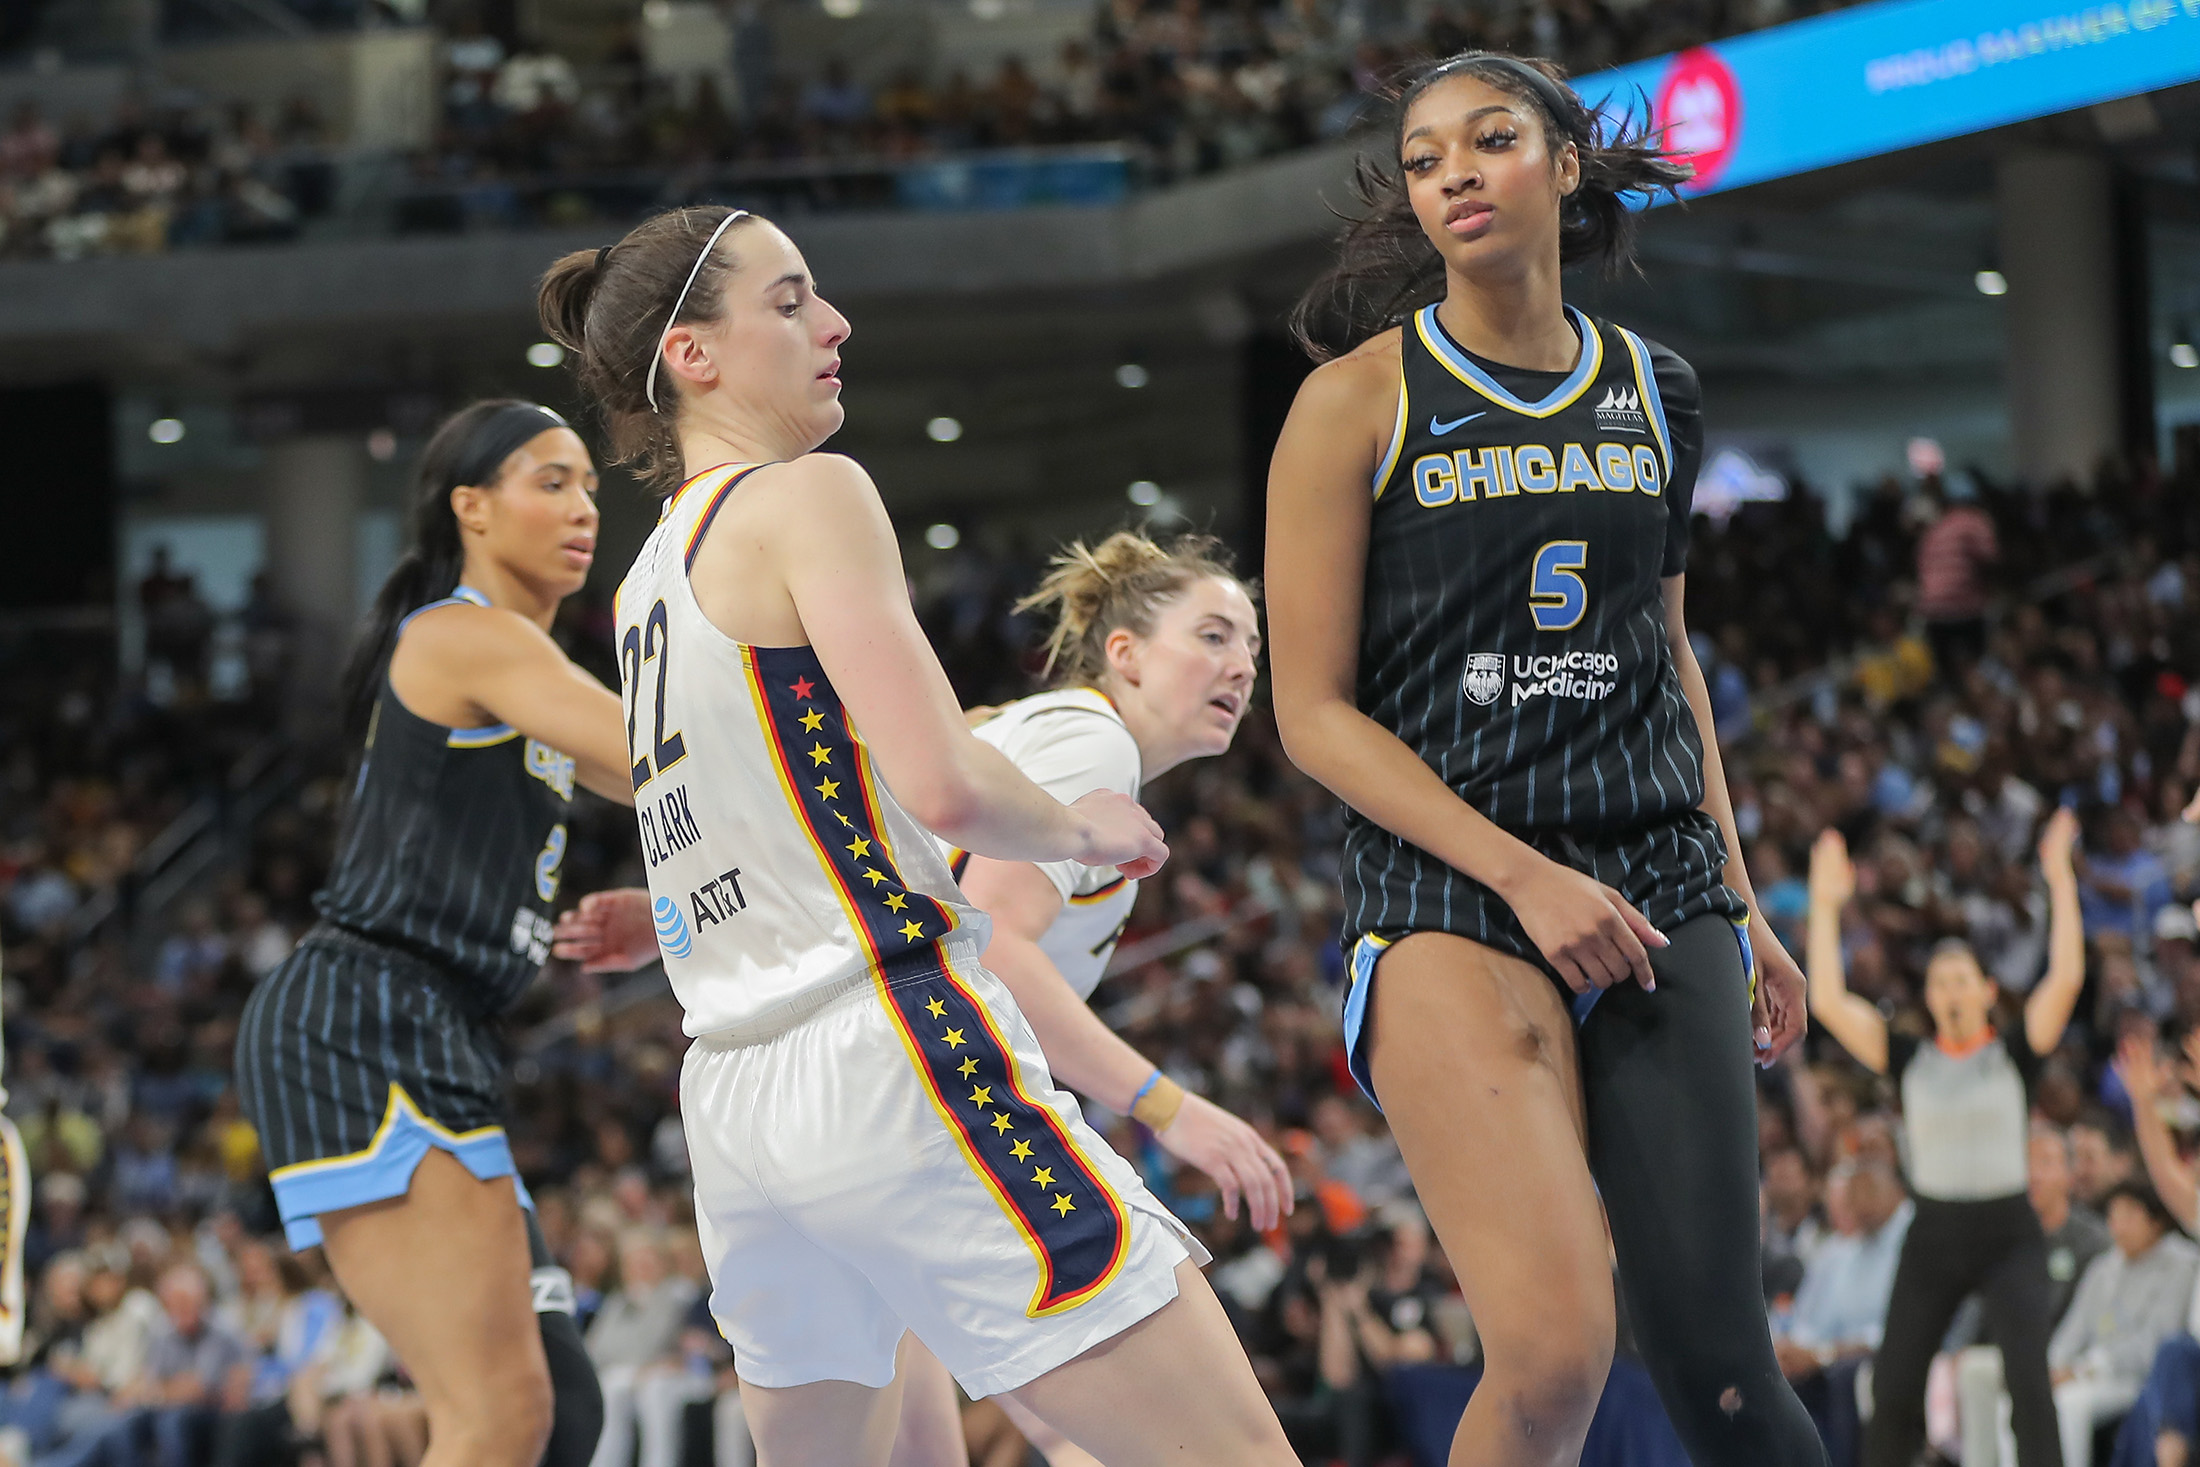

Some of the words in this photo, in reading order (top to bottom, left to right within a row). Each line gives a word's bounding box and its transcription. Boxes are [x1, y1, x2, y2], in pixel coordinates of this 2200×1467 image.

[1412, 443, 1661, 508] CHICAGO
[1528, 540, 1588, 631] 5
[621, 597, 688, 799] 22
[1511, 671, 1617, 708] Medicine
[1513, 651, 1619, 677] UChicago
[640, 783, 702, 868] CLARK
[535, 824, 568, 902] 2
[689, 867, 751, 935] AT&T
